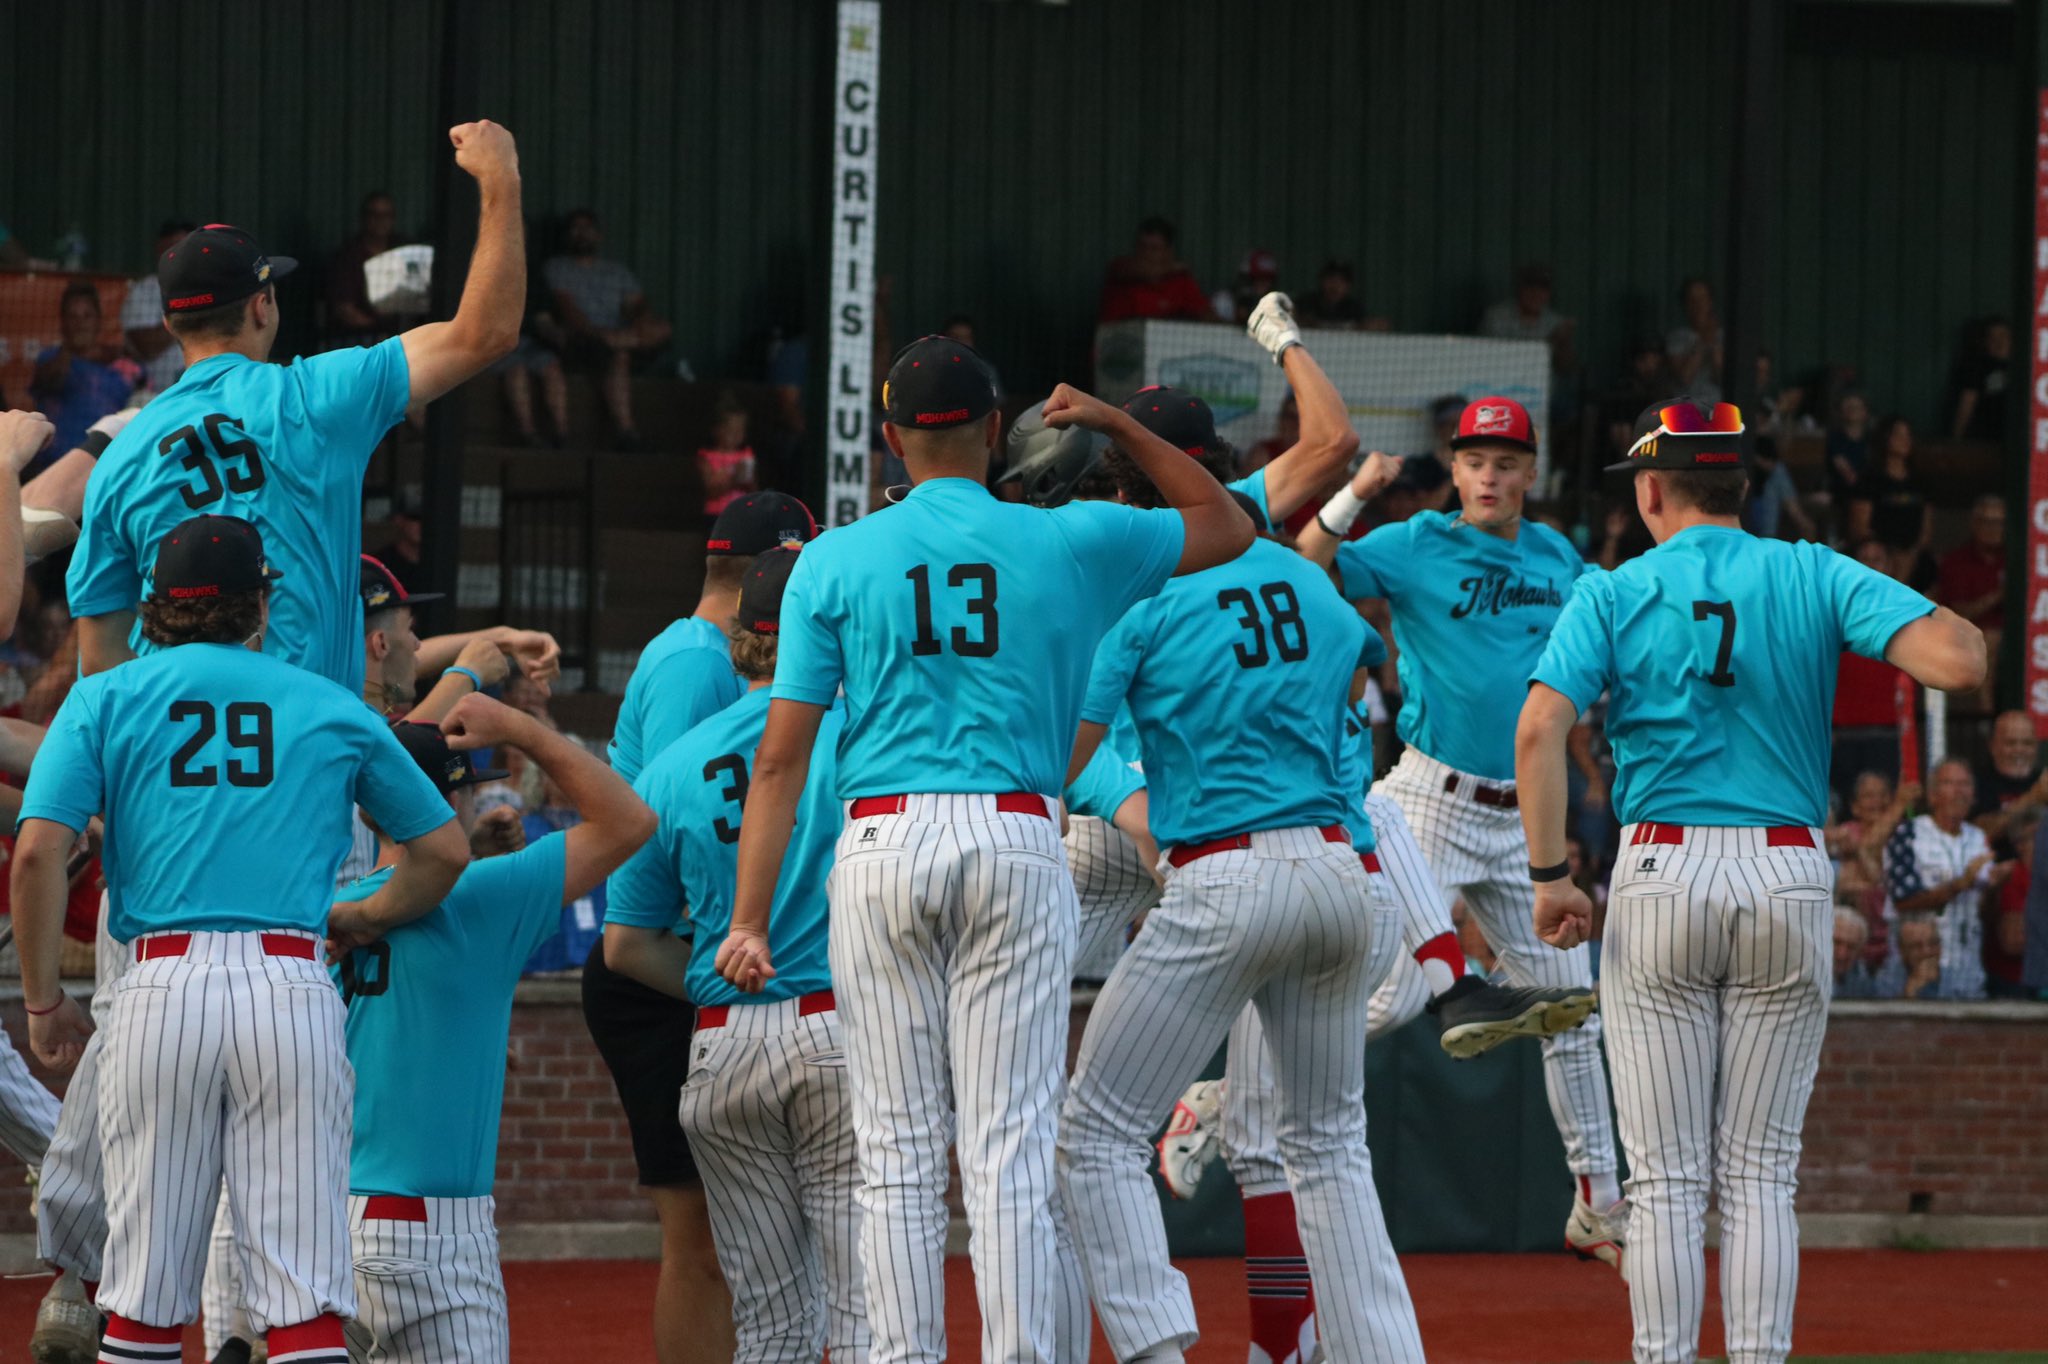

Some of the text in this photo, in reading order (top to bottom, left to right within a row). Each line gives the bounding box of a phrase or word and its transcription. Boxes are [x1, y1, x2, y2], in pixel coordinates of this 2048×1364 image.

[842, 79, 870, 336] CURTIS
[168, 293, 214, 310] MOHAWKS
[915, 408, 969, 424] MOHAWKS
[158, 413, 265, 510] 35
[168, 585, 219, 598] MOHAWKS
[905, 563, 999, 658] 13
[1217, 580, 1309, 669] 38
[1450, 565, 1563, 619] Mohawks
[1692, 600, 1737, 687] 7
[169, 700, 274, 788] 29
[702, 752, 751, 845] 3
[1641, 857, 1656, 868] R
